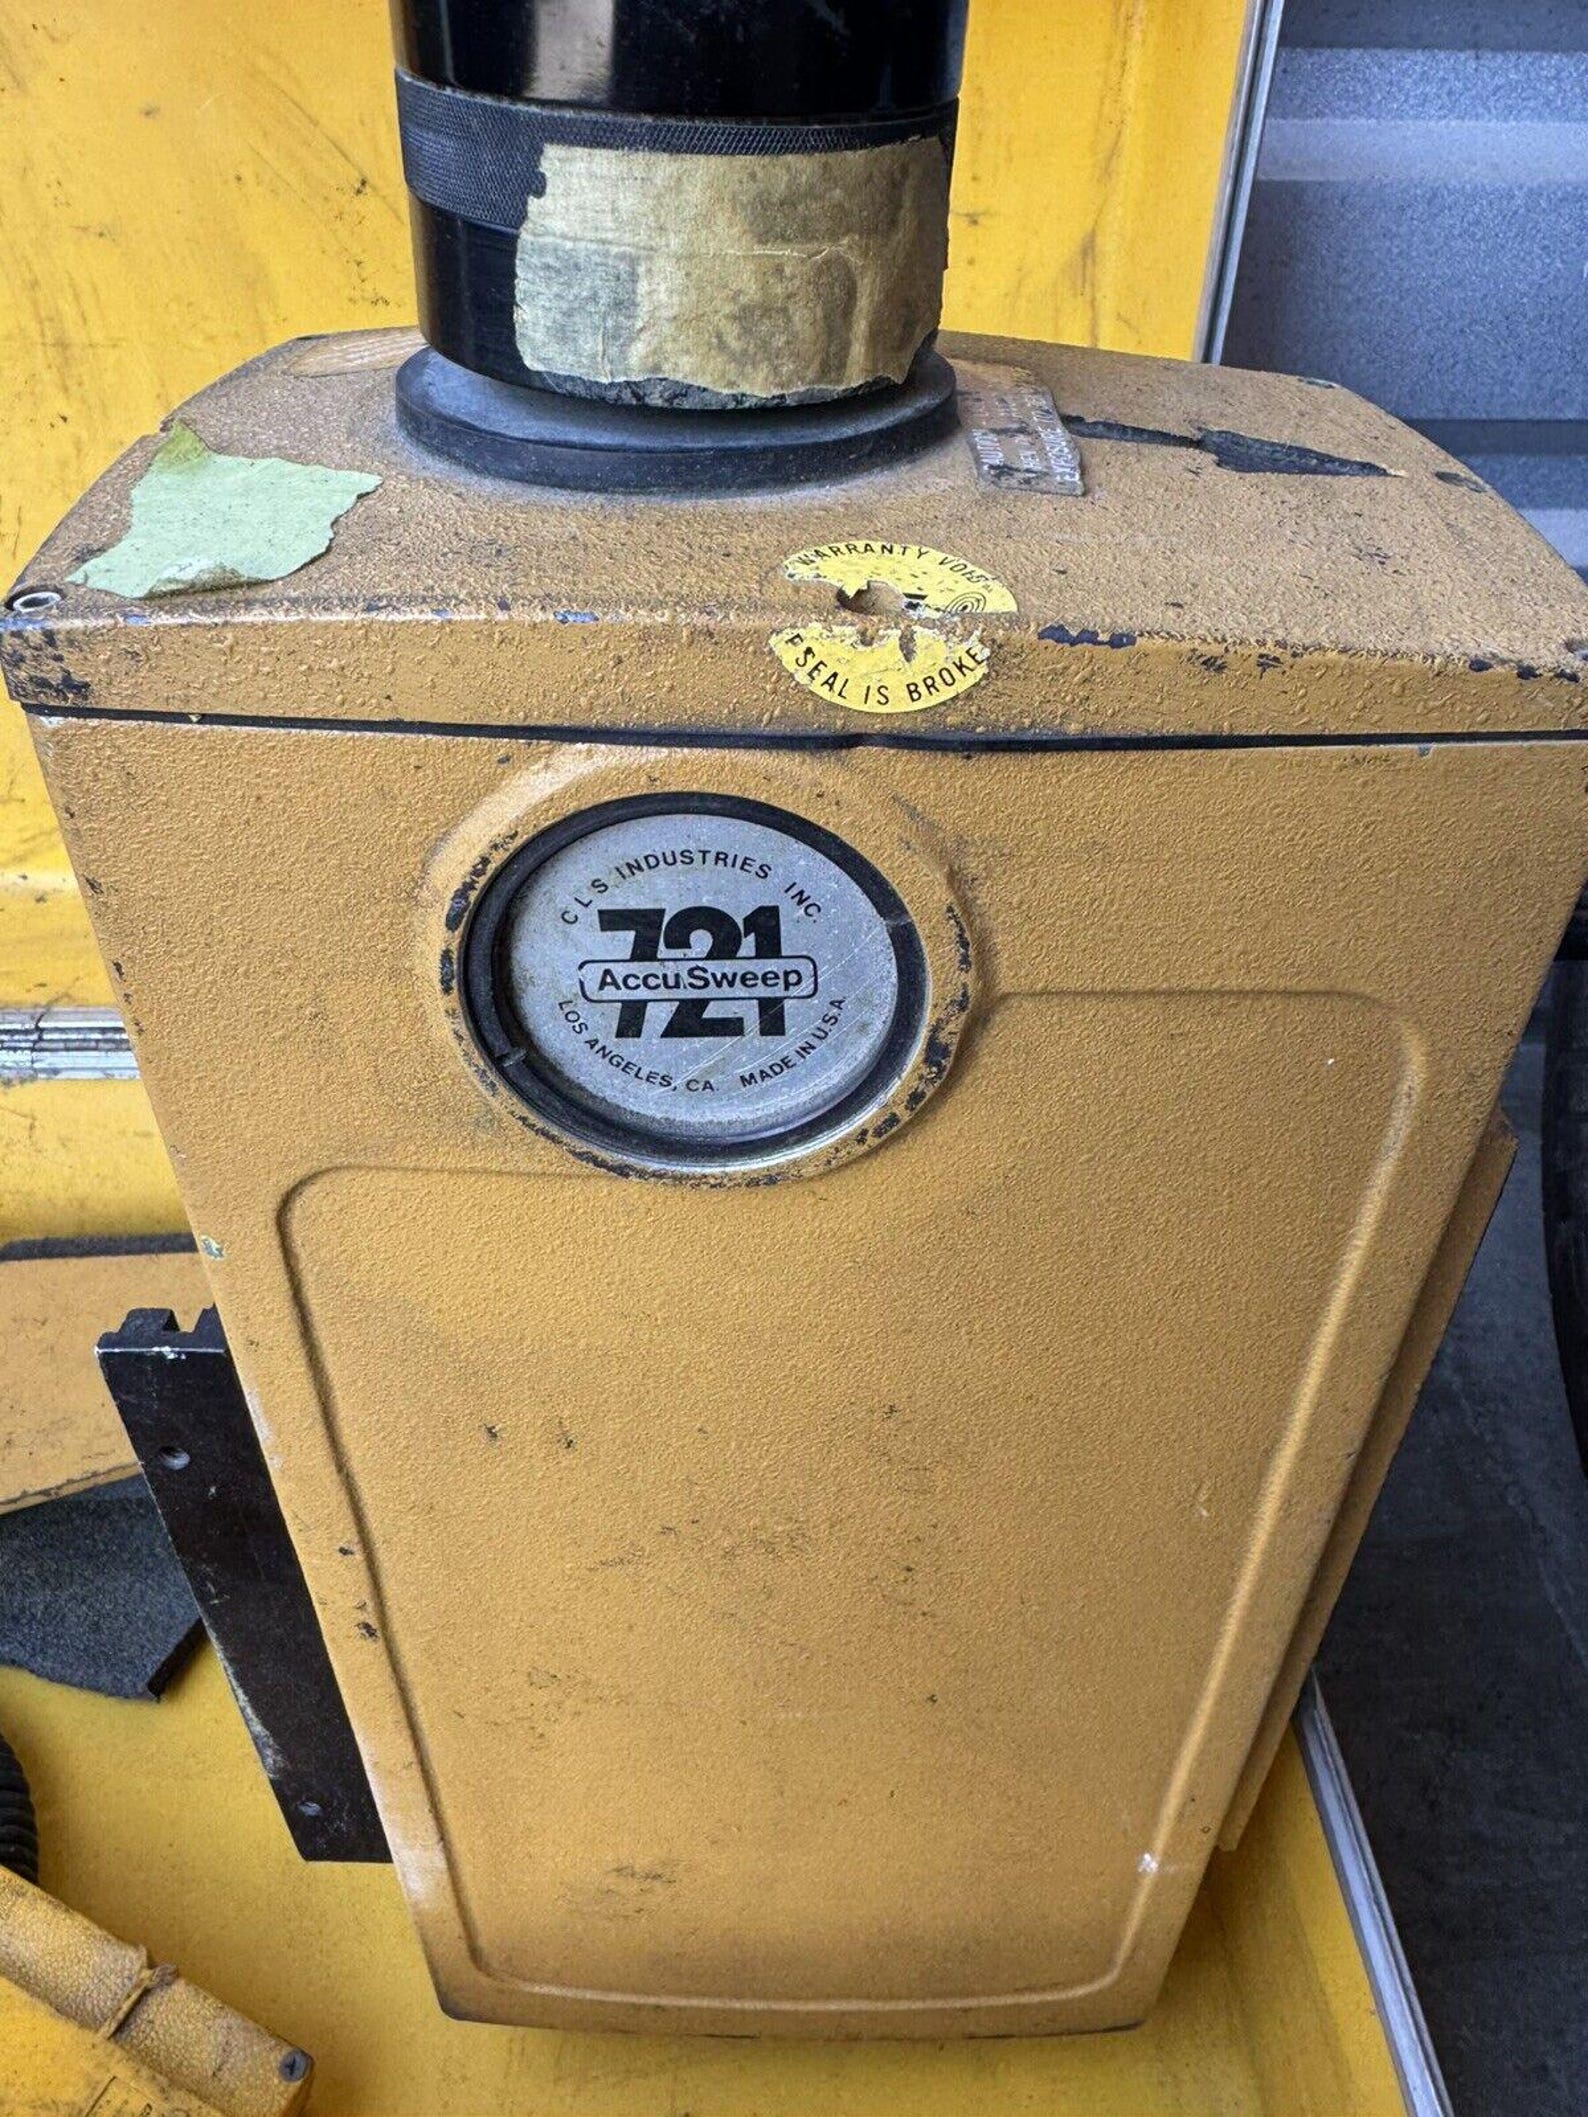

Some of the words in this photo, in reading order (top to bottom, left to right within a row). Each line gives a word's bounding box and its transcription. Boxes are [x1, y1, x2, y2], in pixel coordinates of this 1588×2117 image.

[797, 543, 930, 567] WARRANTY
[795, 646, 849, 700] SEAL
[863, 685, 890, 705] IS
[615, 850, 772, 880] INDUSTRIES
[784, 881, 821, 924] INC.
[598, 904, 787, 1039] 721
[598, 964, 803, 991] AccuSweep
[558, 1001, 588, 1034] LOS
[585, 1038, 677, 1092] ANGELES,
[685, 1079, 719, 1093] CA.
[740, 1055, 797, 1087] MADE
[795, 1040, 817, 1060] IN
